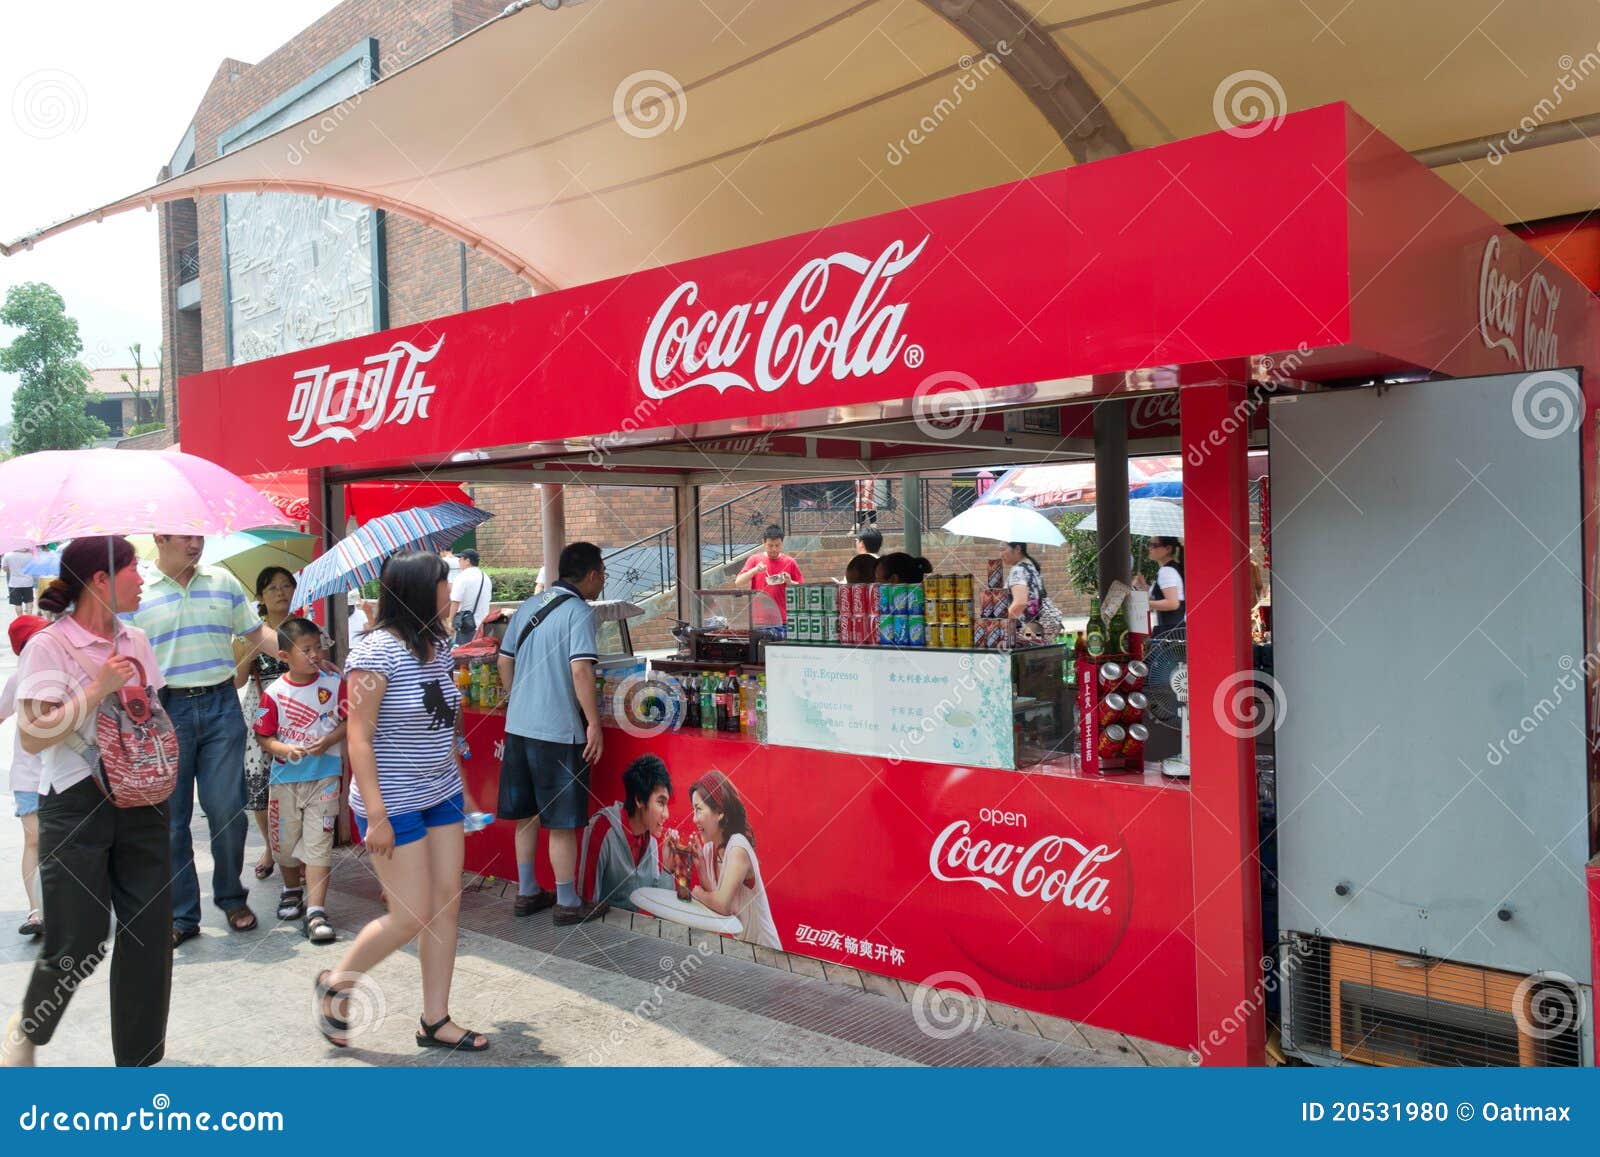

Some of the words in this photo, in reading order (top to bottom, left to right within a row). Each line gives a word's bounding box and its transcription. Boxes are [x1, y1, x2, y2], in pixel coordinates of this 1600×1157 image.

[638, 233, 931, 400] Coca-Cola
[286, 333, 446, 447] 可口可乐
[979, 807, 1027, 828] open
